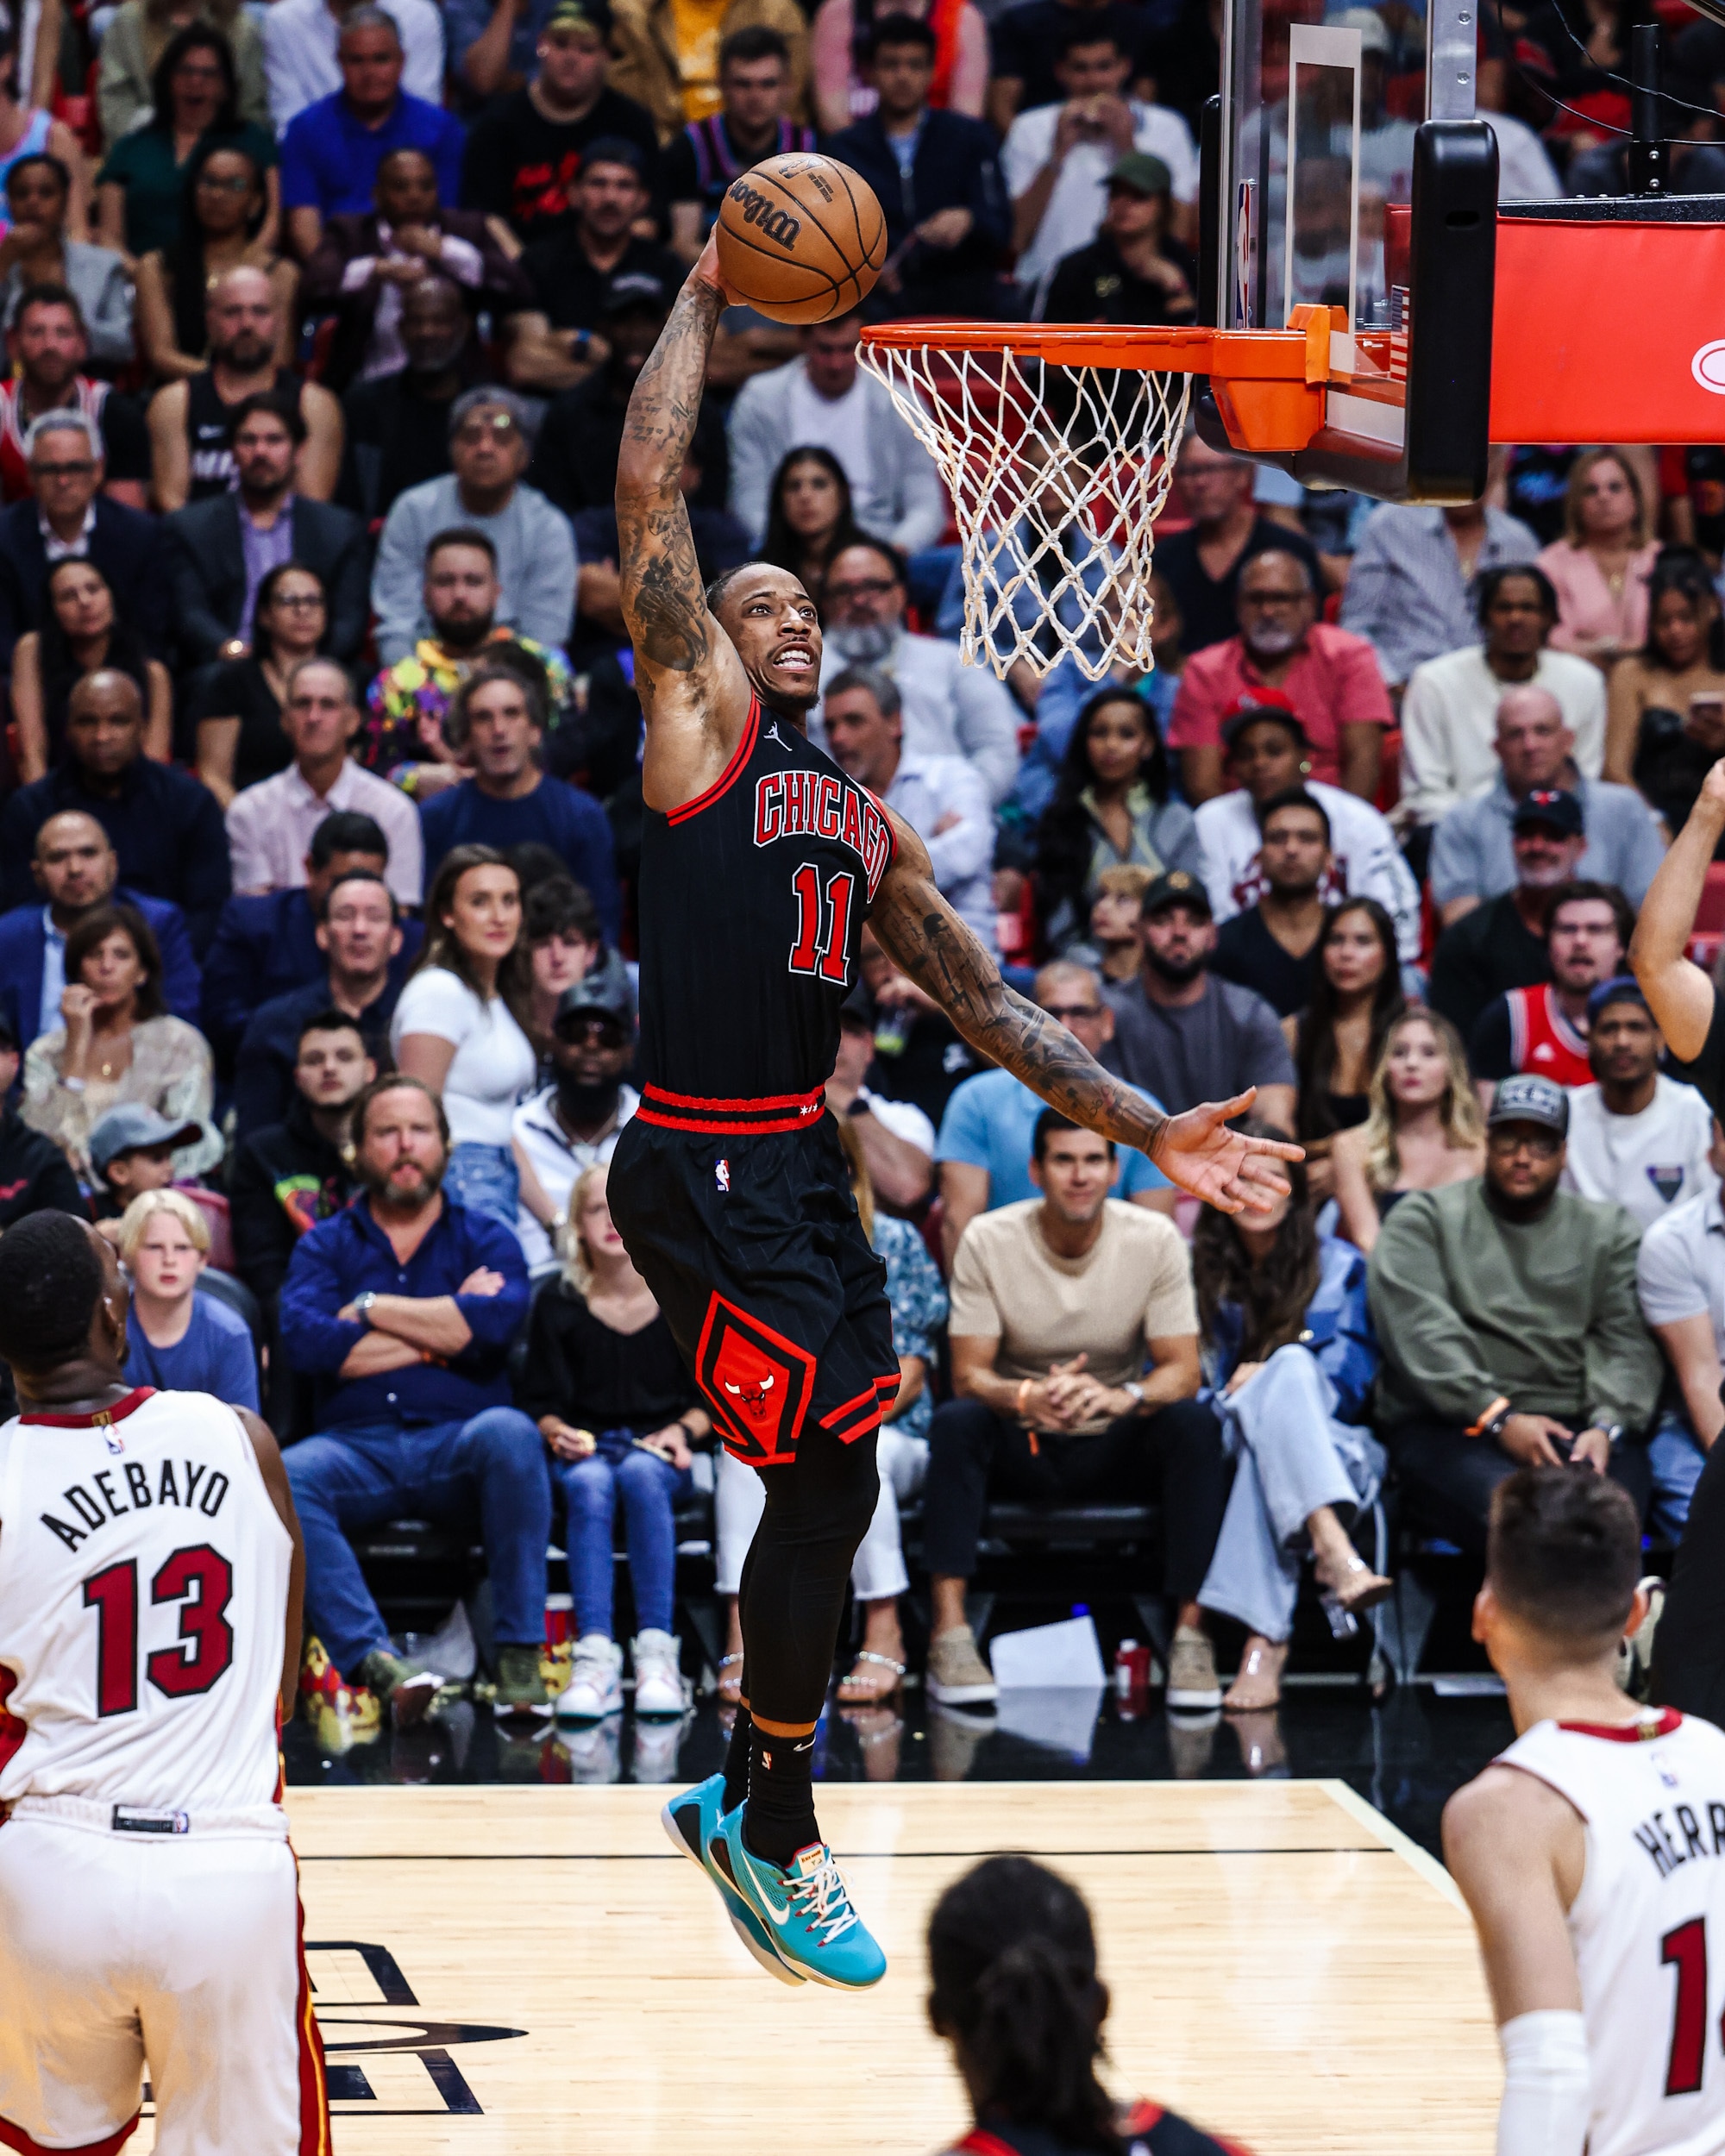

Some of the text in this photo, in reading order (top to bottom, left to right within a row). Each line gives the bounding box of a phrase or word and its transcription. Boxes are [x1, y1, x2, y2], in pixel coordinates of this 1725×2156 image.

[729, 179, 801, 251] Wilson
[753, 770, 889, 904] CHICAGO
[788, 862, 855, 987] 11
[40, 1459, 229, 1553] ADEBAYO
[81, 1543, 233, 1718] 13
[1660, 1914, 1725, 2098] 1
